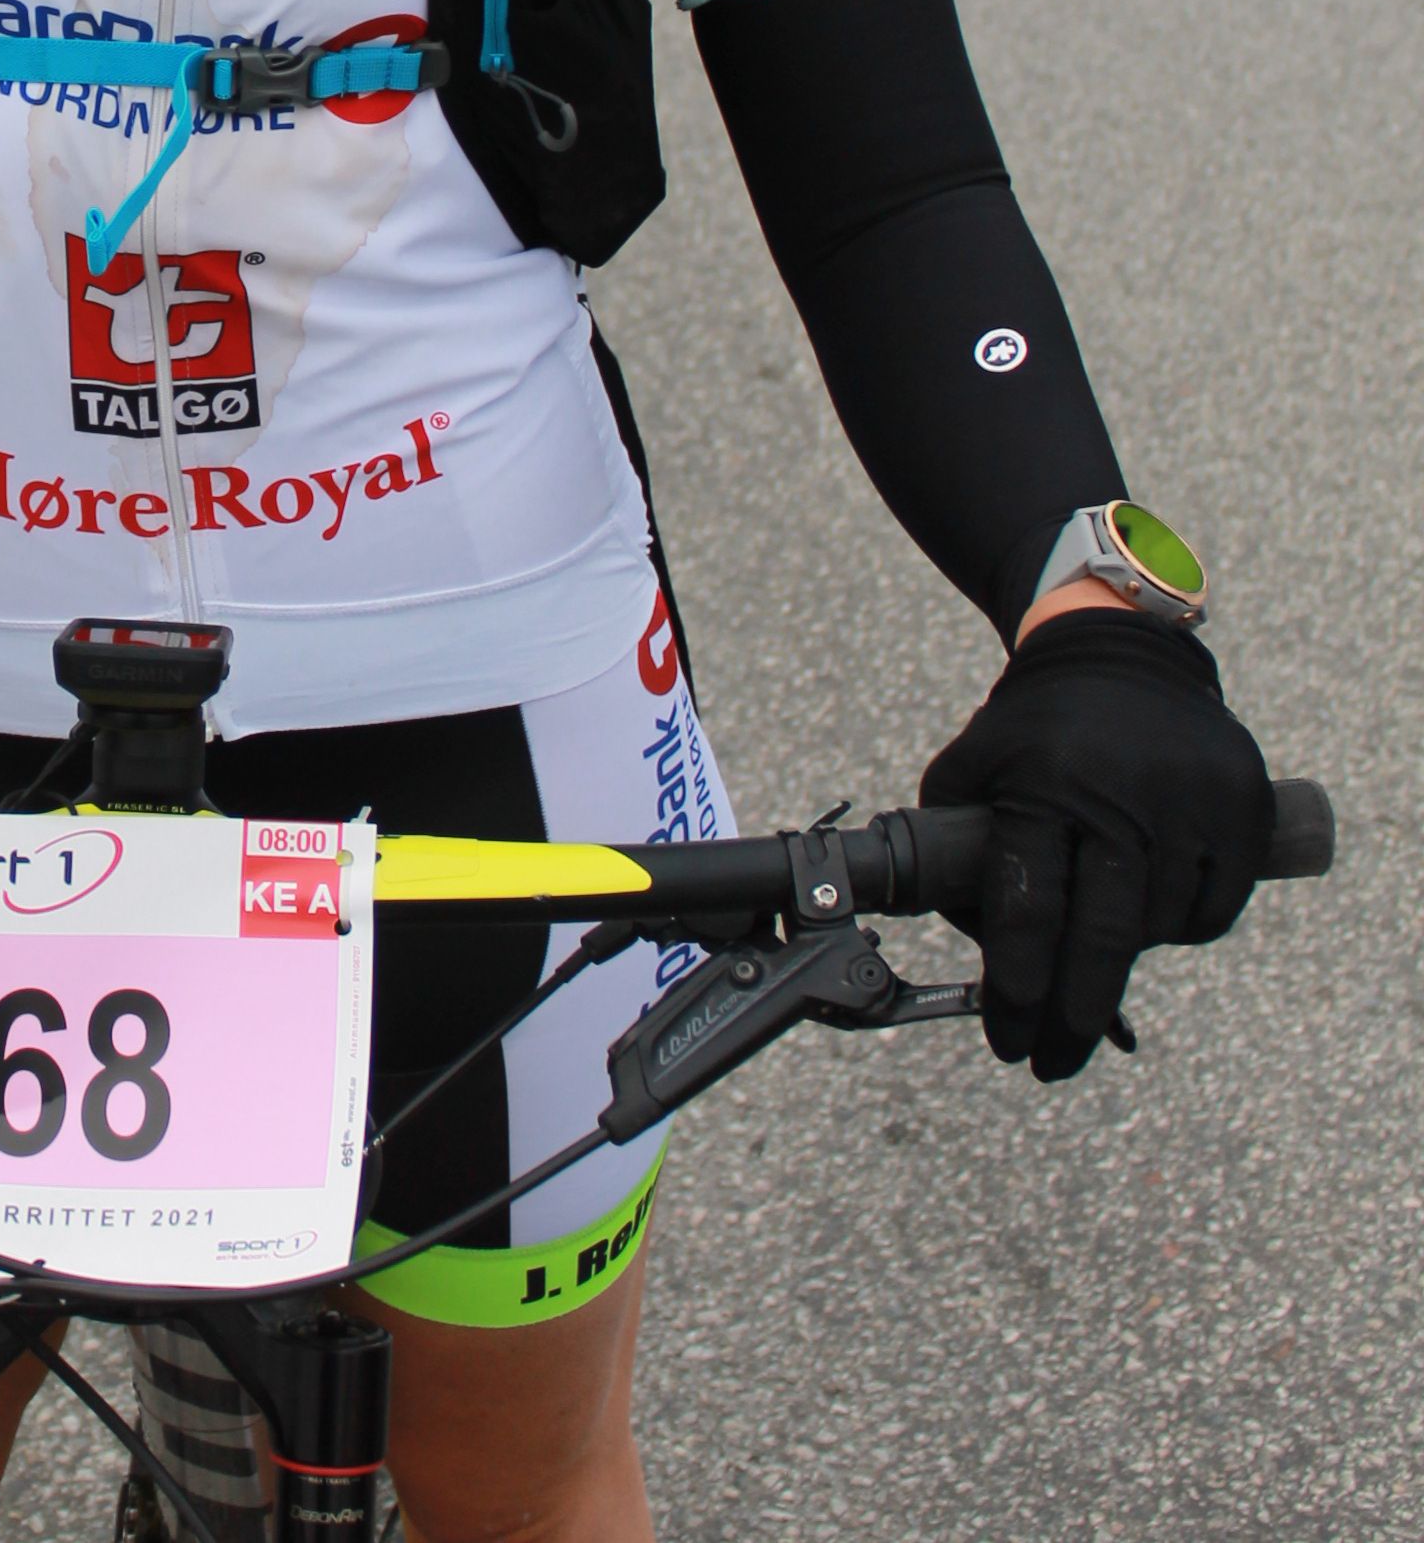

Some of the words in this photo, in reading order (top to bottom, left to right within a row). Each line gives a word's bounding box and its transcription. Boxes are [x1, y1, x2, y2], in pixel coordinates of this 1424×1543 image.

[78, 387, 251, 431] TALGØ
[181, 417, 444, 541] Royal
[87, 664, 184, 683] GARMIN
[107, 802, 153, 812] FRASER
[258, 828, 327, 853] 08:00
[59, 850, 74, 886] 1
[244, 880, 298, 913] KE
[307, 883, 337, 914] A
[150, 1209, 216, 1227] 2021
[218, 1238, 285, 1253] sport
[520, 1266, 562, 1304] J.
